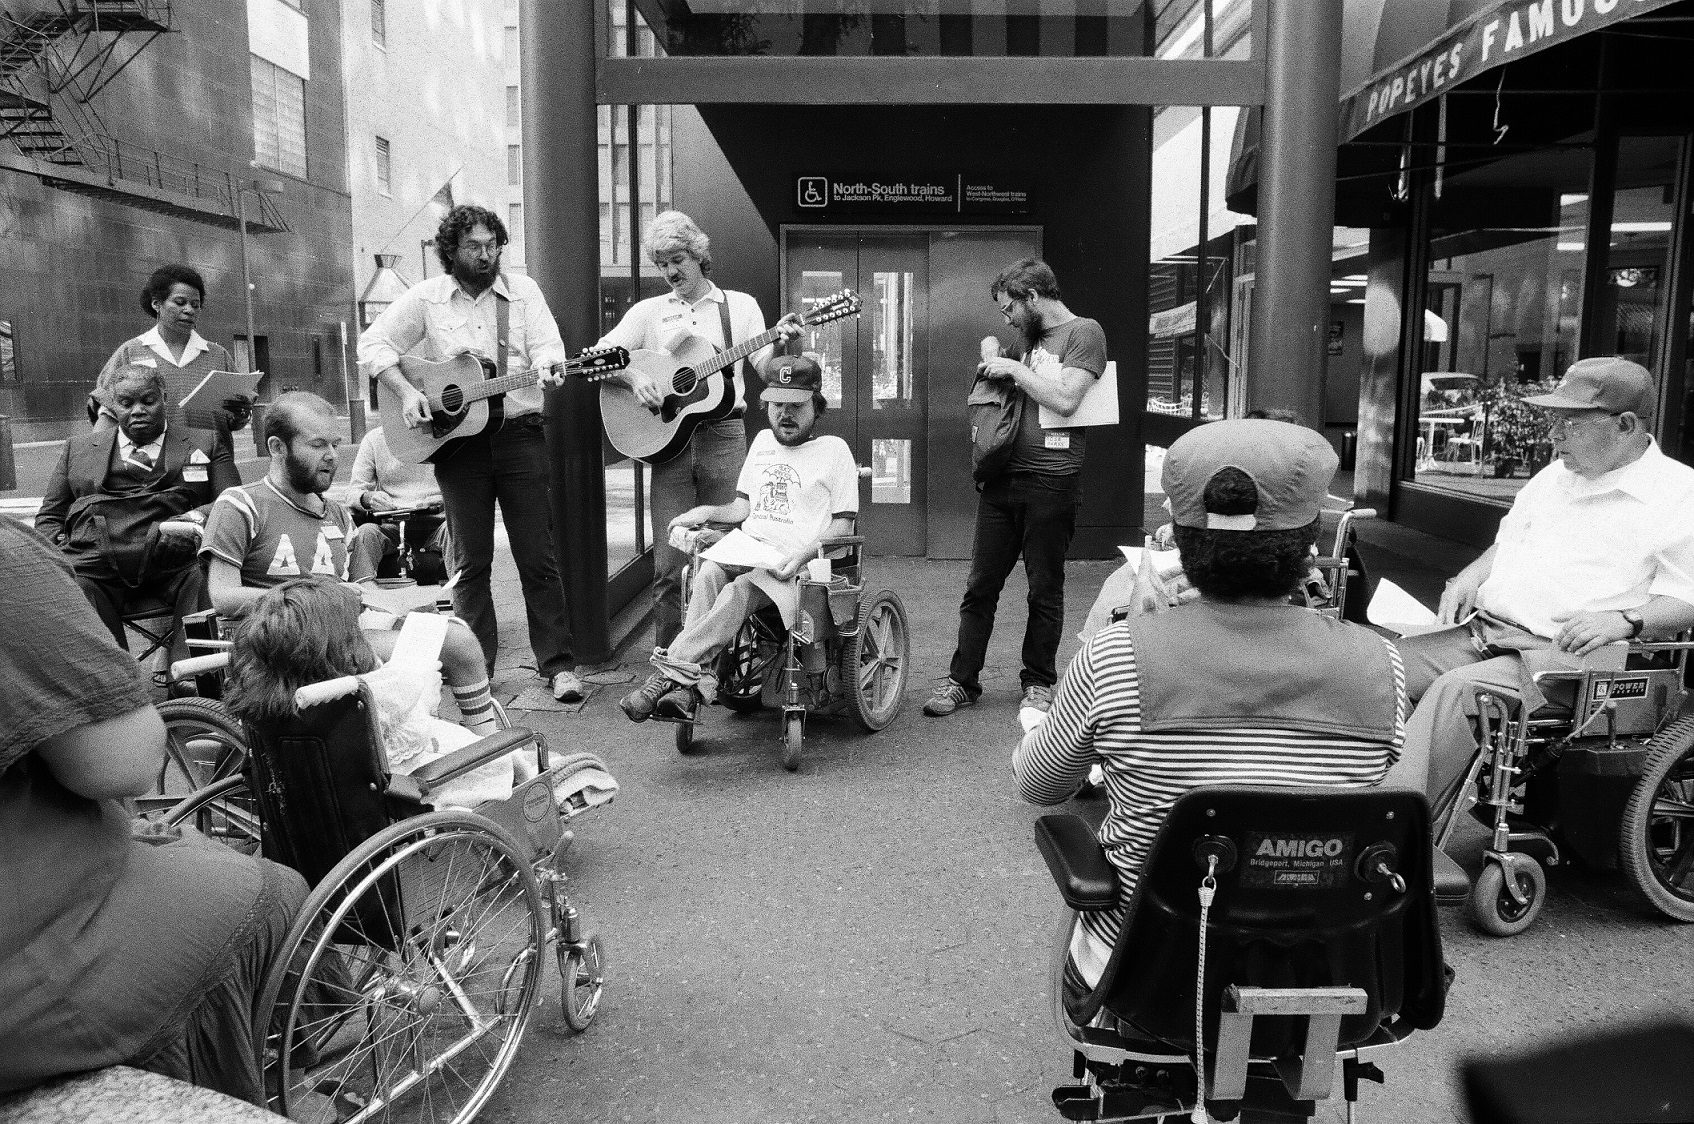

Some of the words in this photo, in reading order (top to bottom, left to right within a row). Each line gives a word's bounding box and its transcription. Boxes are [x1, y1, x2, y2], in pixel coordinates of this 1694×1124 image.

[1366, 42, 1463, 122] POPEYES
[1482, 0, 1646, 62] FAMO
[833, 182, 907, 195] North-South
[910, 183, 945, 195] trains
[925, 194, 953, 202] Howard
[779, 366, 792, 384] C
[1613, 682, 1645, 690] POWER
[1255, 838, 1343, 857] AMIGO
[1250, 858, 1290, 869] Bridgeport,
[1293, 859, 1325, 869] Michigan
[1329, 858, 1343, 867] USA
